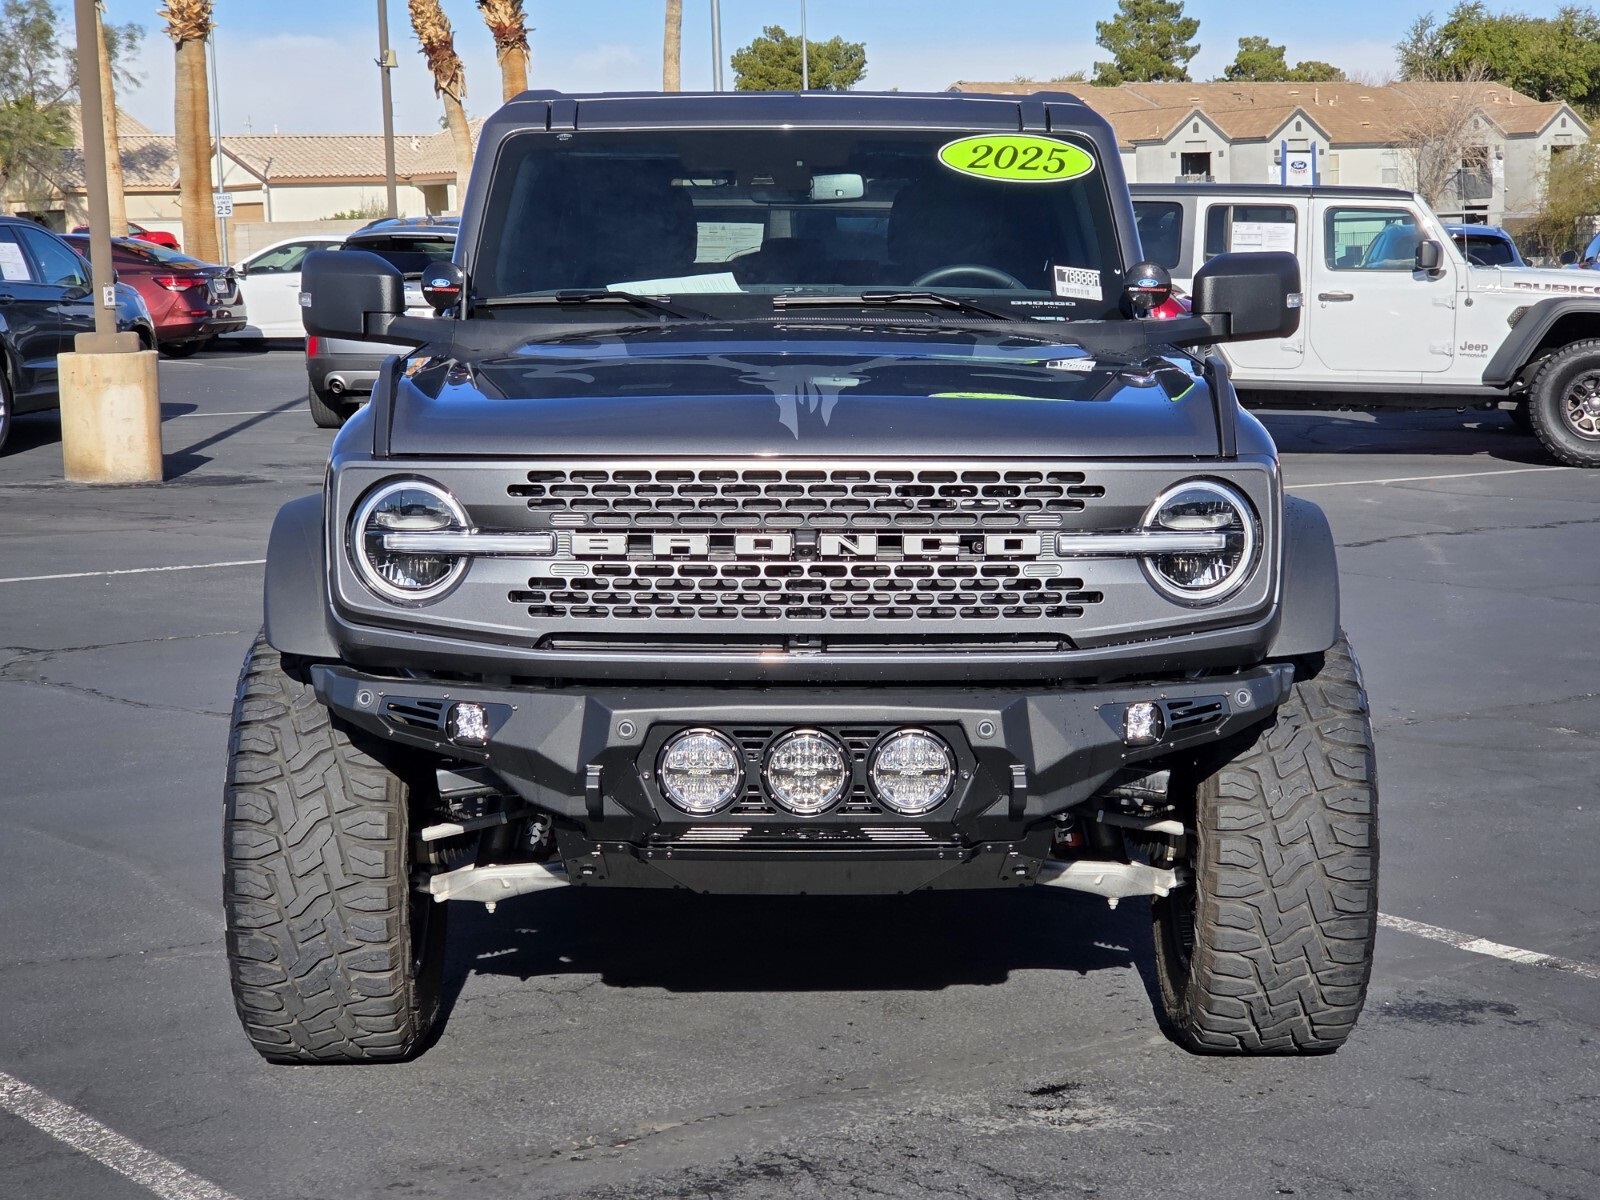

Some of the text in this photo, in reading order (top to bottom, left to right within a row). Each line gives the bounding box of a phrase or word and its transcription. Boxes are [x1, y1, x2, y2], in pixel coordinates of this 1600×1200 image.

[967, 144, 1069, 174] 2025
[217, 205, 231, 215] 25
[1460, 341, 1488, 353] Jeep
[571, 534, 1042, 556] BRONCO
